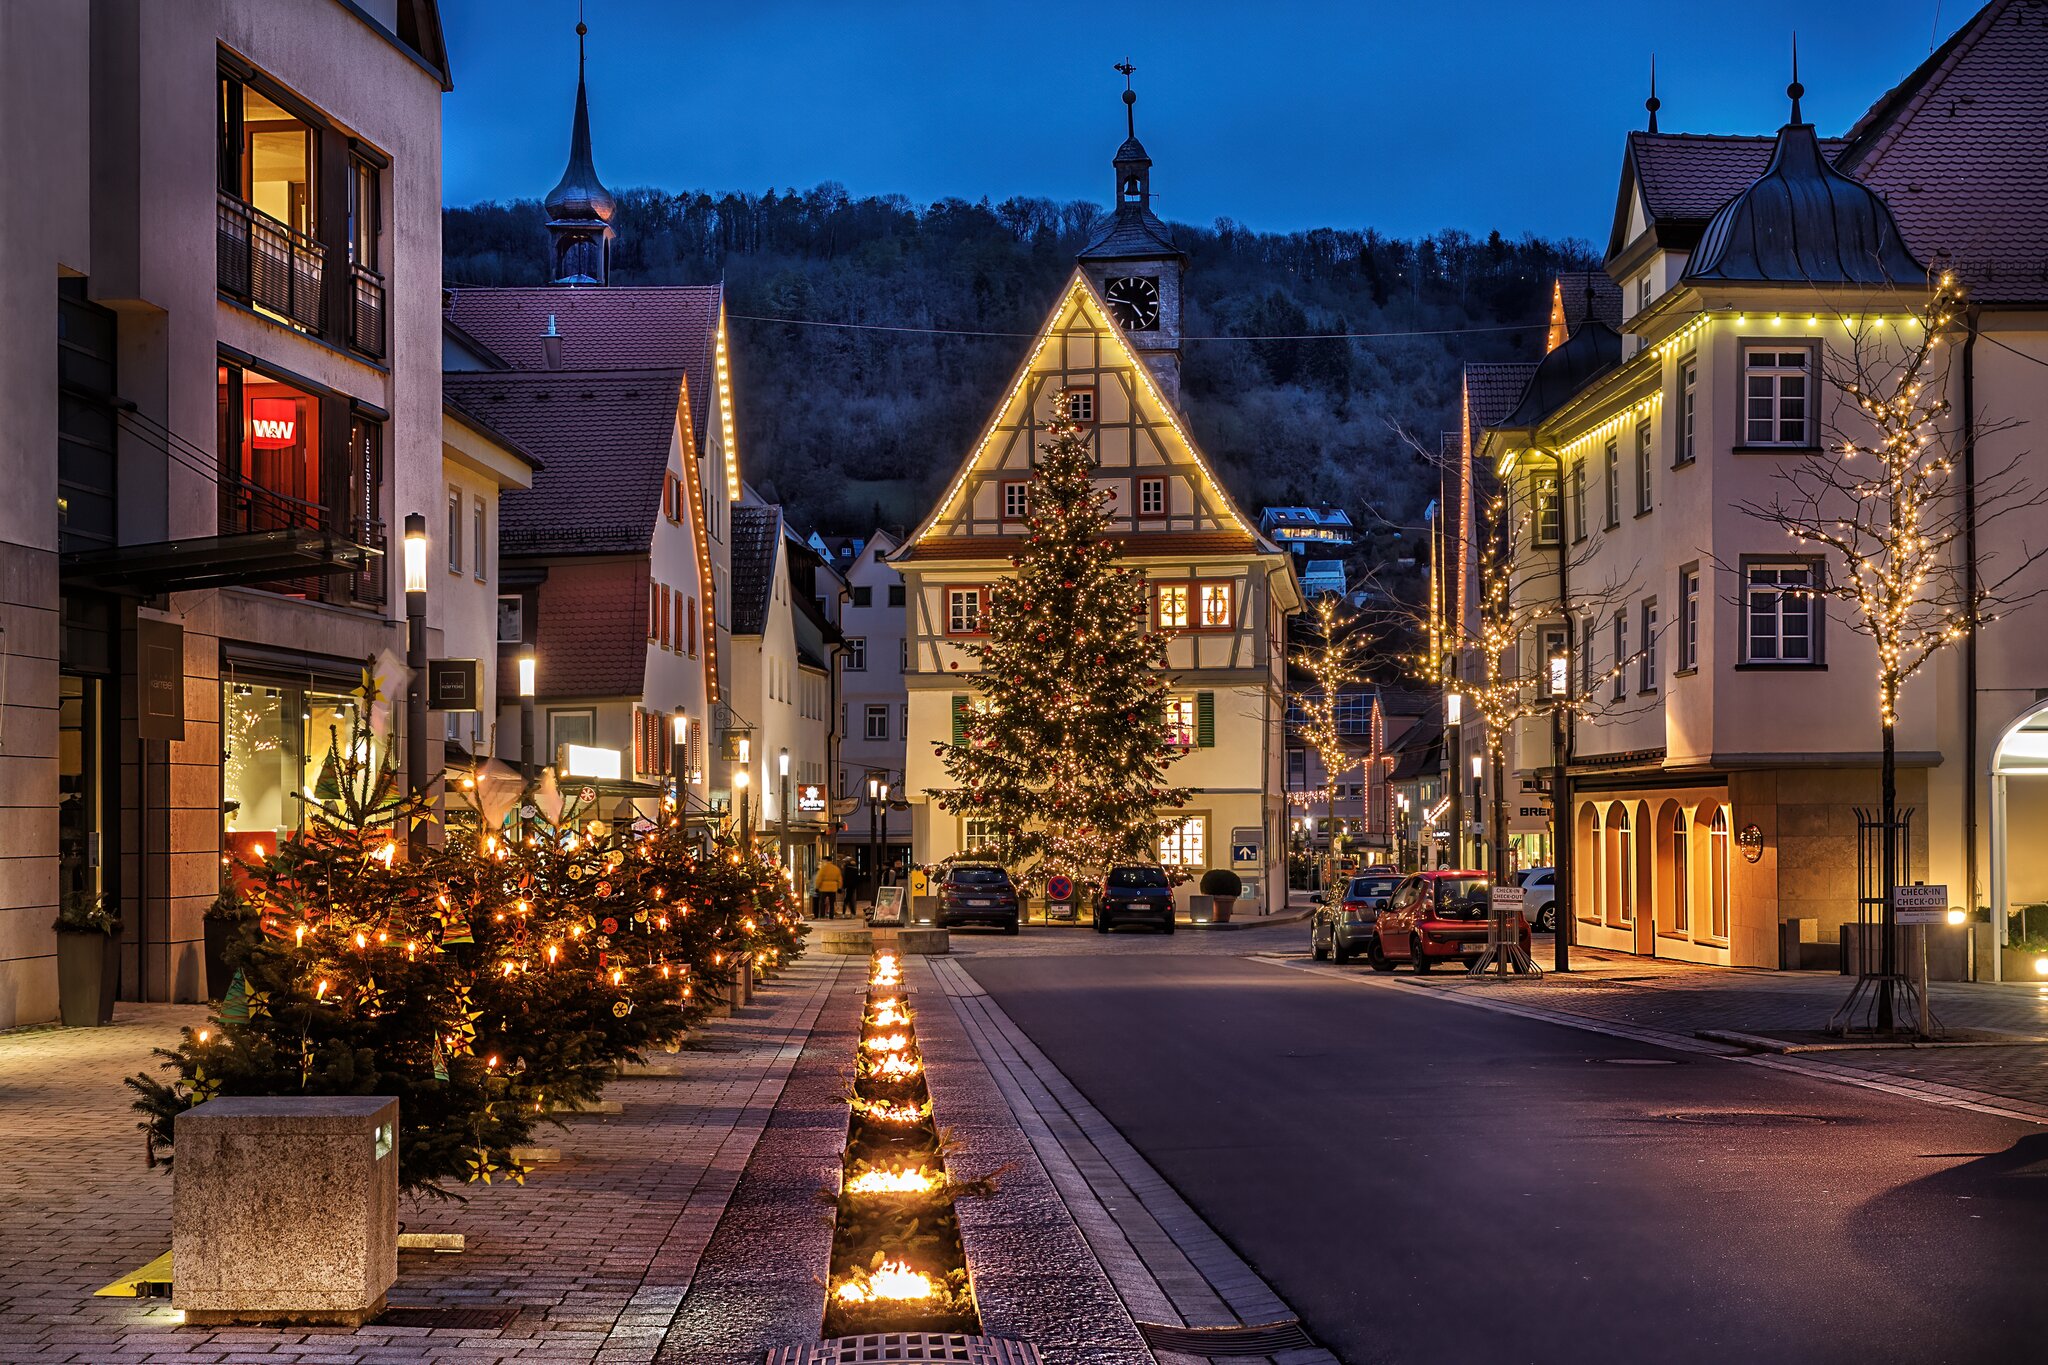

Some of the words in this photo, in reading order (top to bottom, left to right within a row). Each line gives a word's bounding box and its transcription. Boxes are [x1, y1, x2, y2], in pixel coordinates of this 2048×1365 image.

[253, 419, 294, 439] W&W
[1901, 888, 1940, 896] CHECK-IN
[1897, 897, 1945, 906] CHECK-OUT
